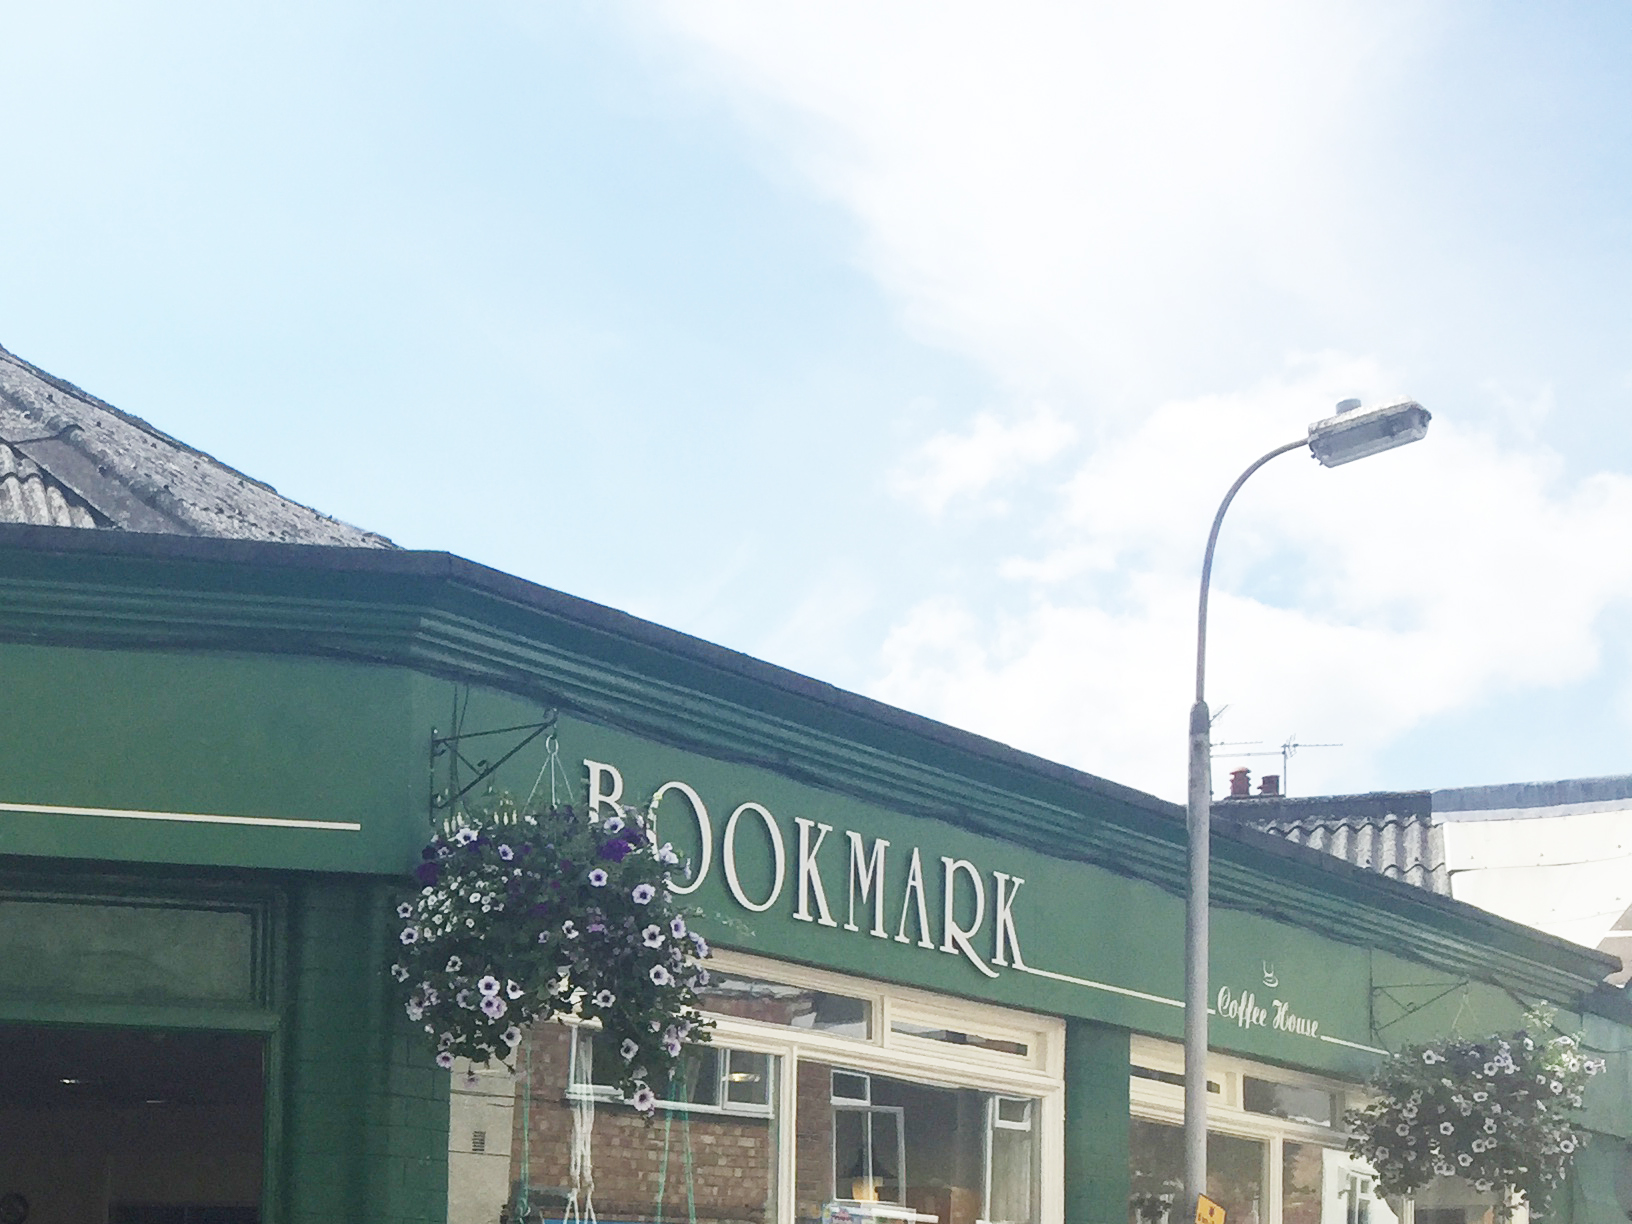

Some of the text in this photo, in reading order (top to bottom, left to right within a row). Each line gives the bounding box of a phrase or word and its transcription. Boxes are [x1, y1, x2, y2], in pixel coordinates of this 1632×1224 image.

[583, 759, 1030, 978] BOOKMARK
[1217, 985, 1319, 1038] Coffee House
